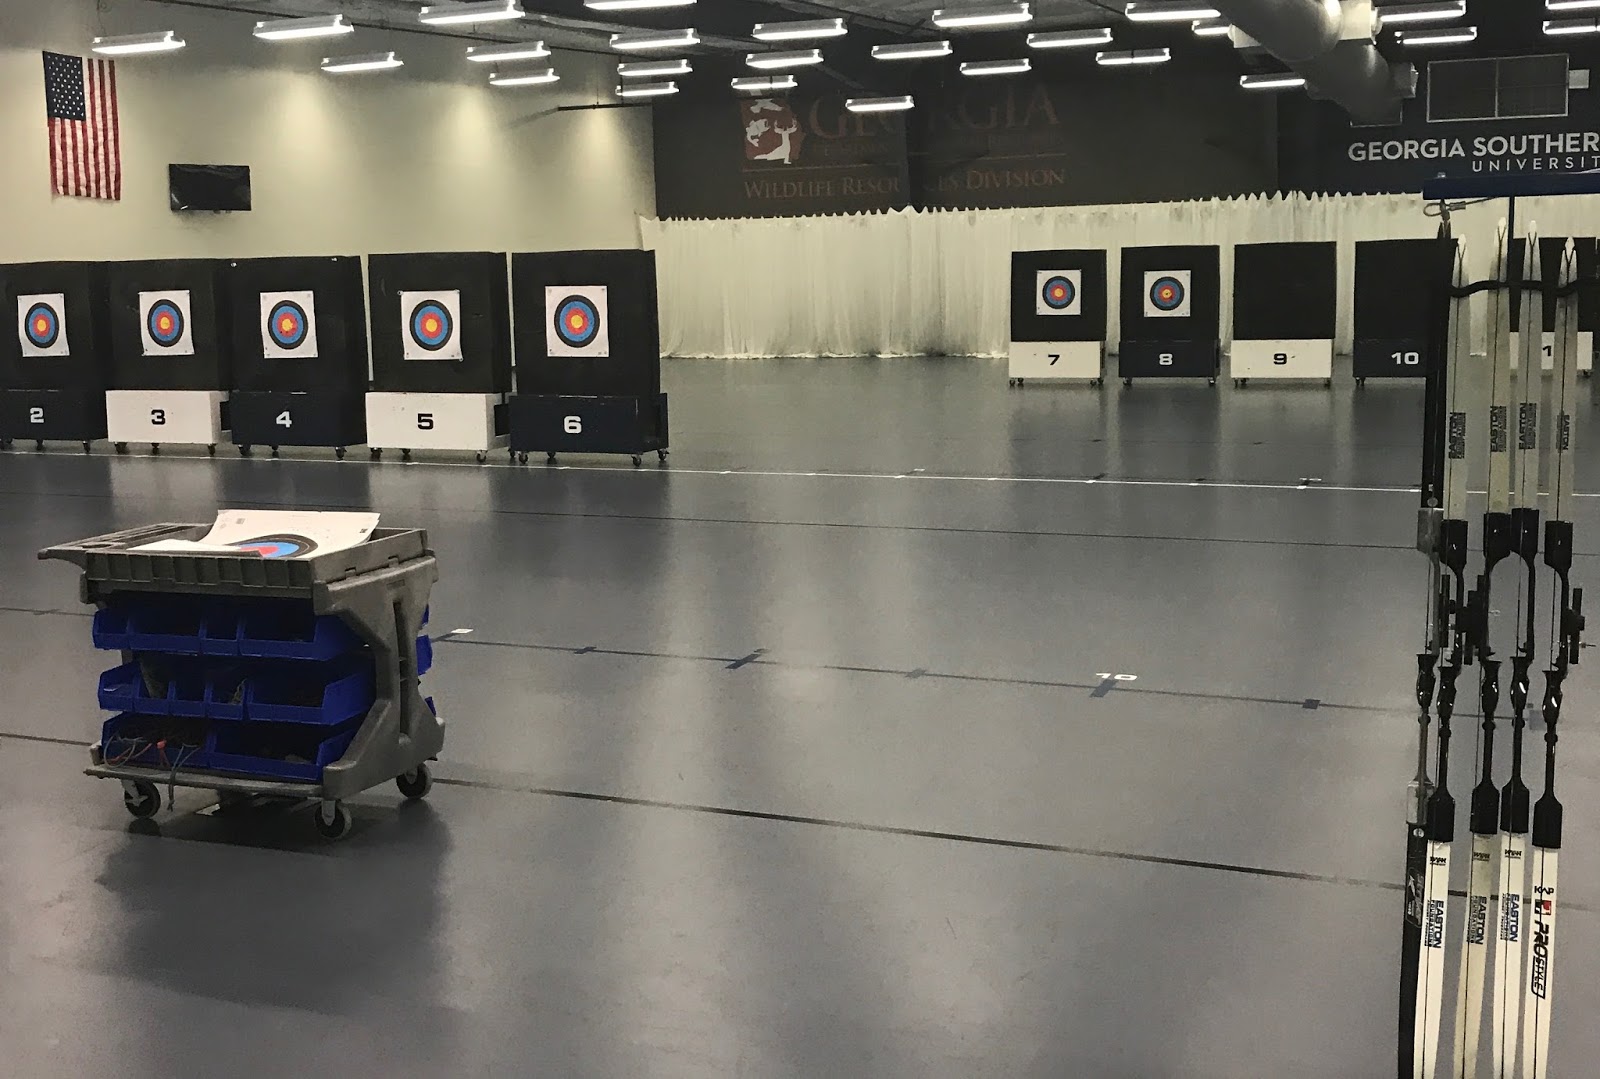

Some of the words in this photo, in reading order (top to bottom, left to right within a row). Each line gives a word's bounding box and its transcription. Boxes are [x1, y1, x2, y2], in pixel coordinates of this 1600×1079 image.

[1348, 138, 1466, 162] GEORGIA
[1472, 131, 1600, 156] SOUTHER
[1472, 156, 1600, 172] UNIVERSIT
[743, 177, 834, 200] WILDLIFE
[966, 168, 1066, 190] DIVISION
[1048, 354, 1061, 365] 7
[1273, 354, 1287, 365] 9
[1391, 352, 1419, 365] 10
[1542, 345, 1552, 357] 1
[1159, 354, 1173, 366] 8
[29, 407, 45, 424] 2
[150, 409, 166, 426] 3
[275, 411, 293, 428] 4
[417, 413, 434, 430] 5
[563, 415, 582, 434] 6
[1490, 405, 1499, 452] EASTON
[1433, 899, 1445, 949] EASTON
[1475, 895, 1488, 945] EASTON
[1509, 893, 1520, 942] EASTON
